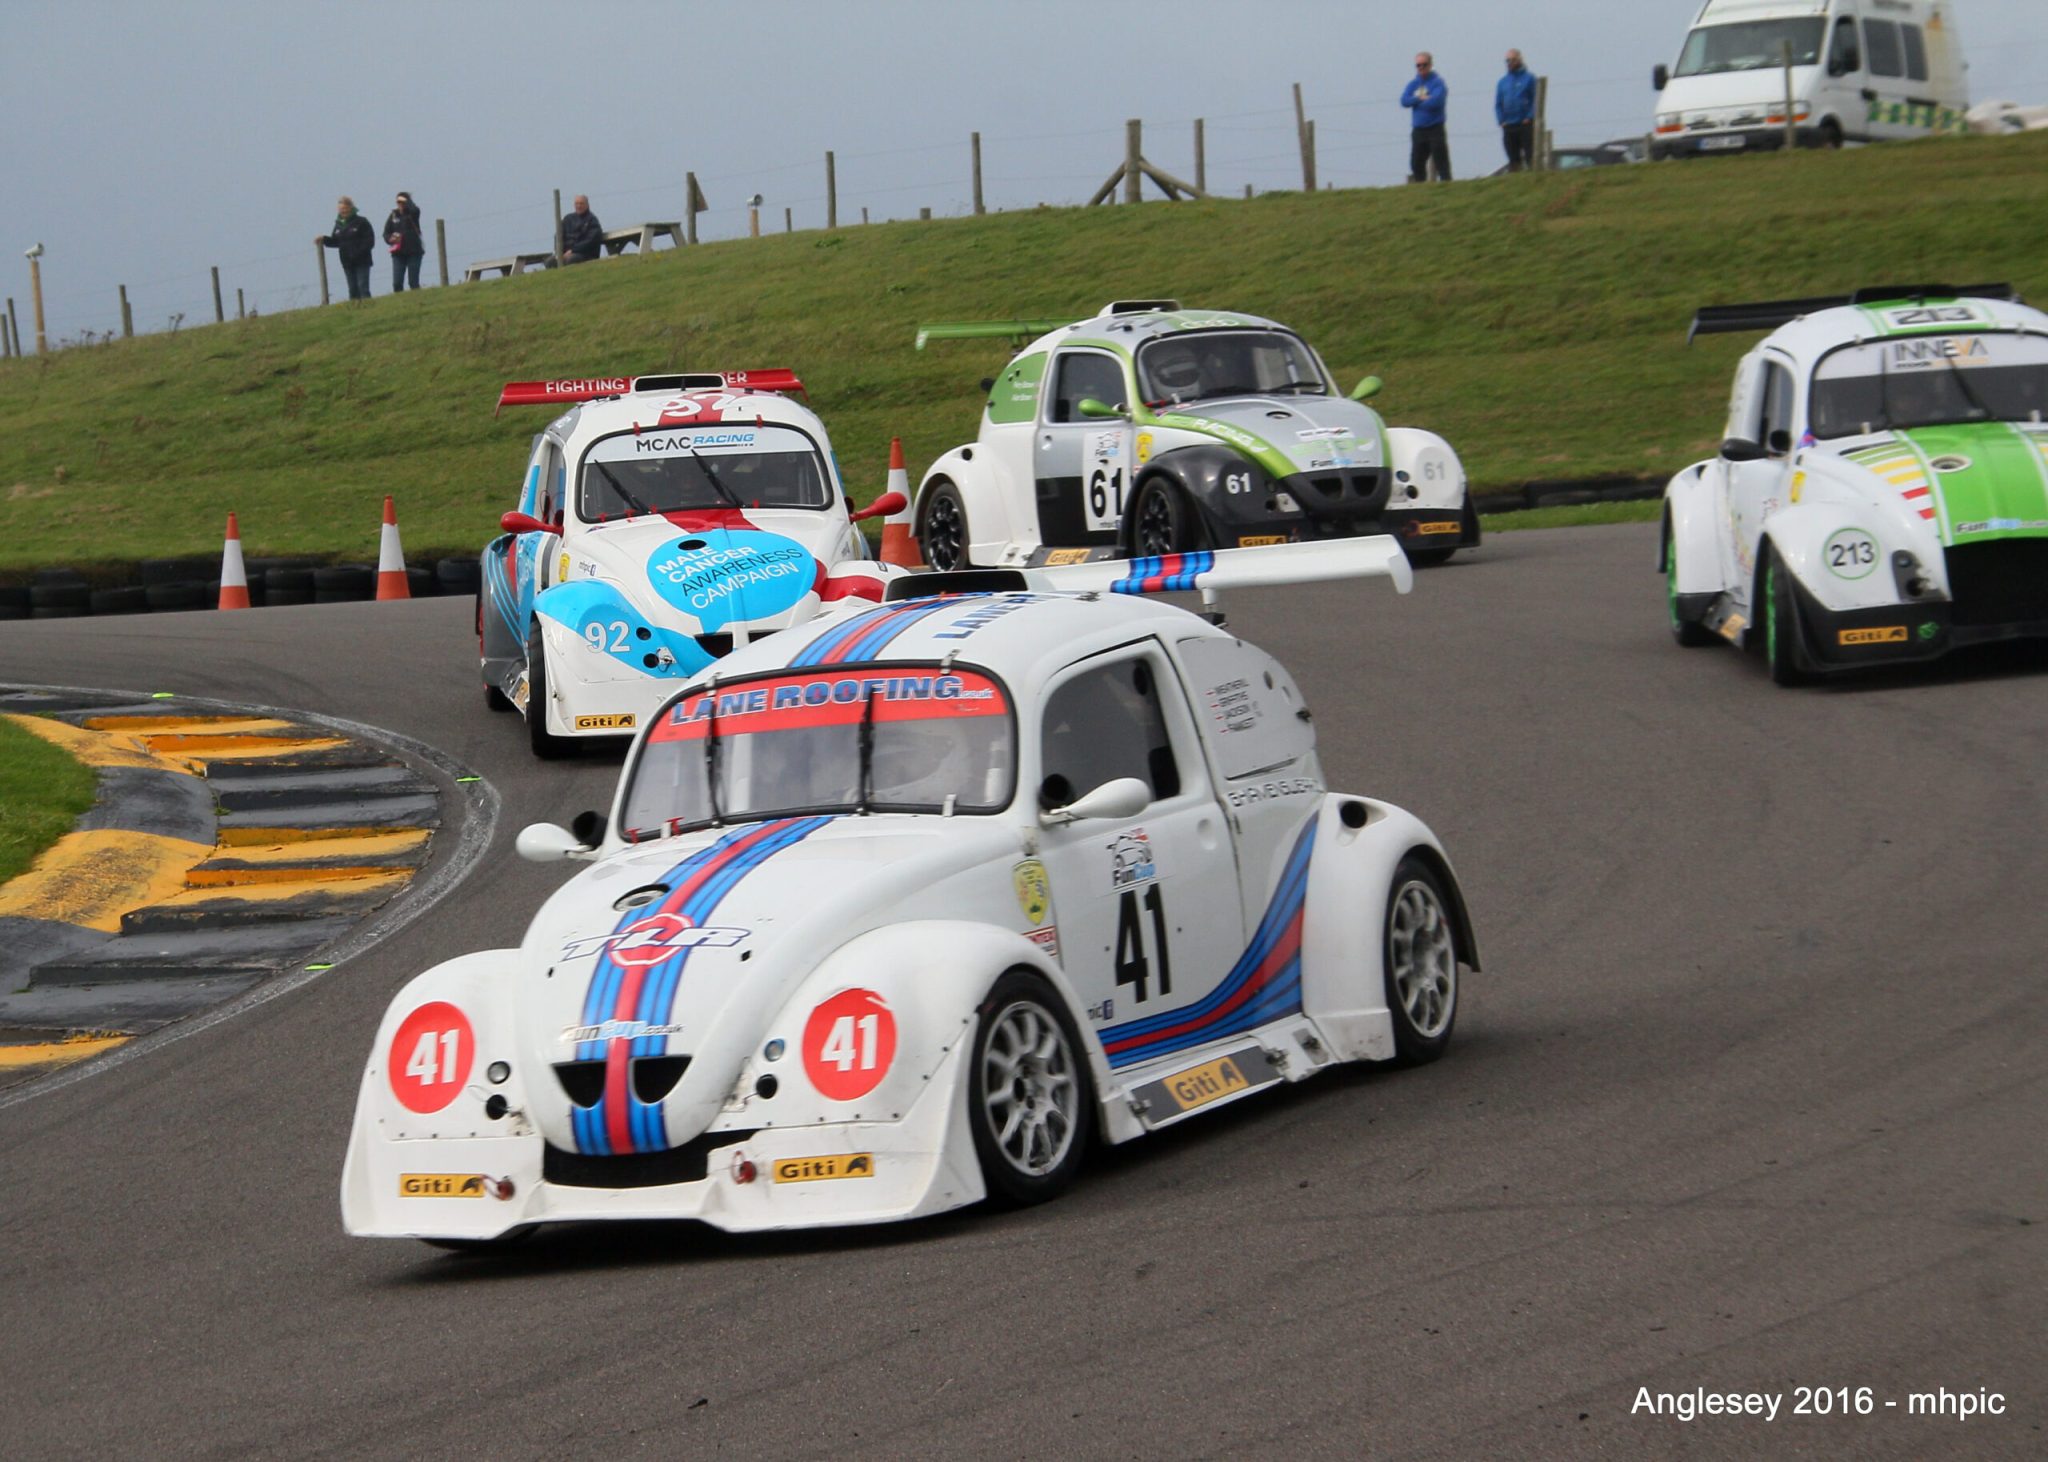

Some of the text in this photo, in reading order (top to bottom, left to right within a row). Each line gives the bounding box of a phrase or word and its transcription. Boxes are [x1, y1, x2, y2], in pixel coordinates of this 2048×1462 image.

[1890, 306, 1977, 325] 213
[545, 379, 625, 393] FIGHTING
[636, 433, 755, 452] MCAC RACING
[1226, 473, 1252, 494] 61
[1424, 461, 1445, 480] 61
[1090, 467, 1123, 518] 61
[656, 546, 716, 574] MALE
[668, 546, 759, 583] CANCER
[1829, 541, 1875, 567] 213
[680, 548, 803, 597] AWARENESS
[691, 562, 800, 609] CAMPAIGN
[584, 620, 632, 653] 92
[578, 716, 613, 728] Giti
[669, 689, 769, 727] LANE
[1115, 881, 1172, 1004] 41
[405, 1028, 461, 1087] 41
[820, 1014, 880, 1072] 41
[1175, 1071, 1222, 1103] Giti
[779, 1160, 835, 1179] Giti
[404, 1177, 453, 1194] Giti
